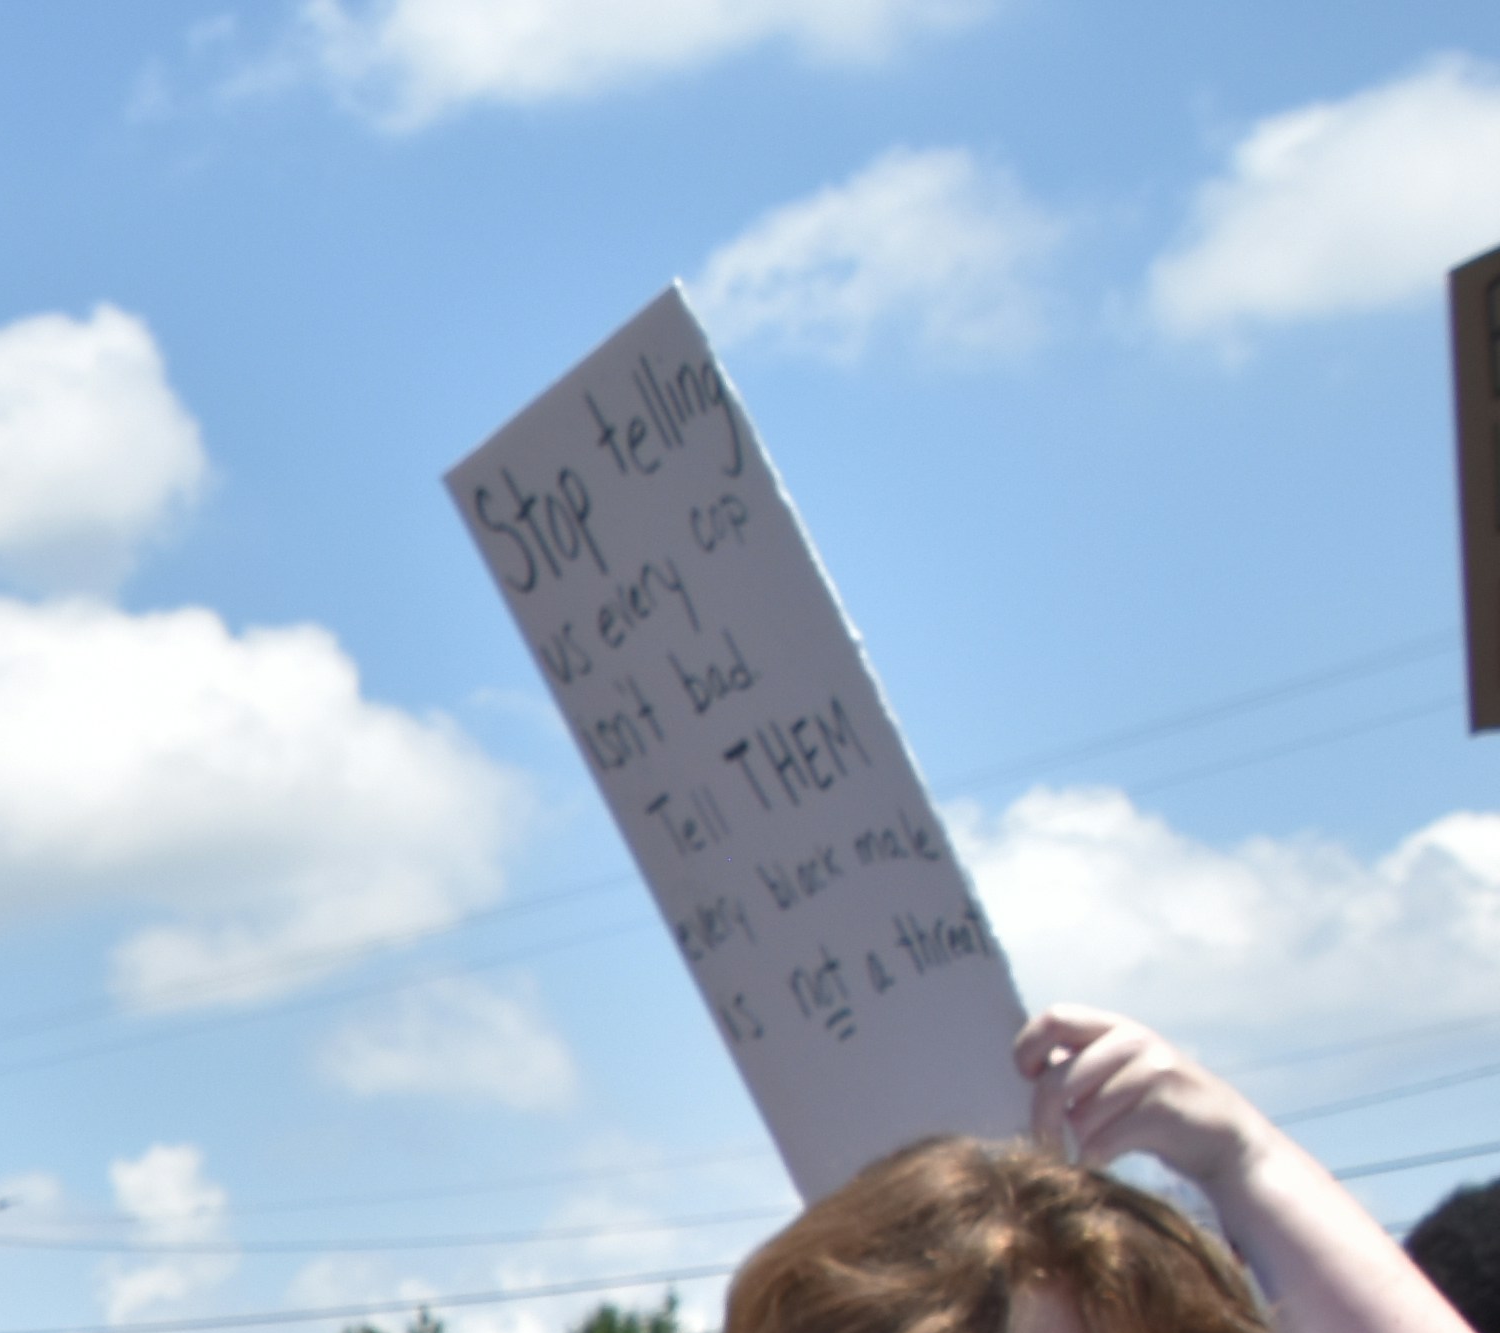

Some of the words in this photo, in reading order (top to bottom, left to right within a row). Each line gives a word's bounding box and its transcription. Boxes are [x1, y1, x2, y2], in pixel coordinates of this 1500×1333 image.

[473, 465, 610, 594] Stop
[583, 353, 745, 479] telling
[540, 621, 593, 684] us
[597, 556, 701, 649] every
[690, 494, 749, 553] cop
[645, 784, 731, 857] Tell
[722, 692, 874, 812] THEM
[852, 804, 943, 866] male
[716, 988, 766, 1042] is
[787, 944, 850, 1020] not
[866, 950, 897, 994] a
[894, 894, 992, 977] threat
